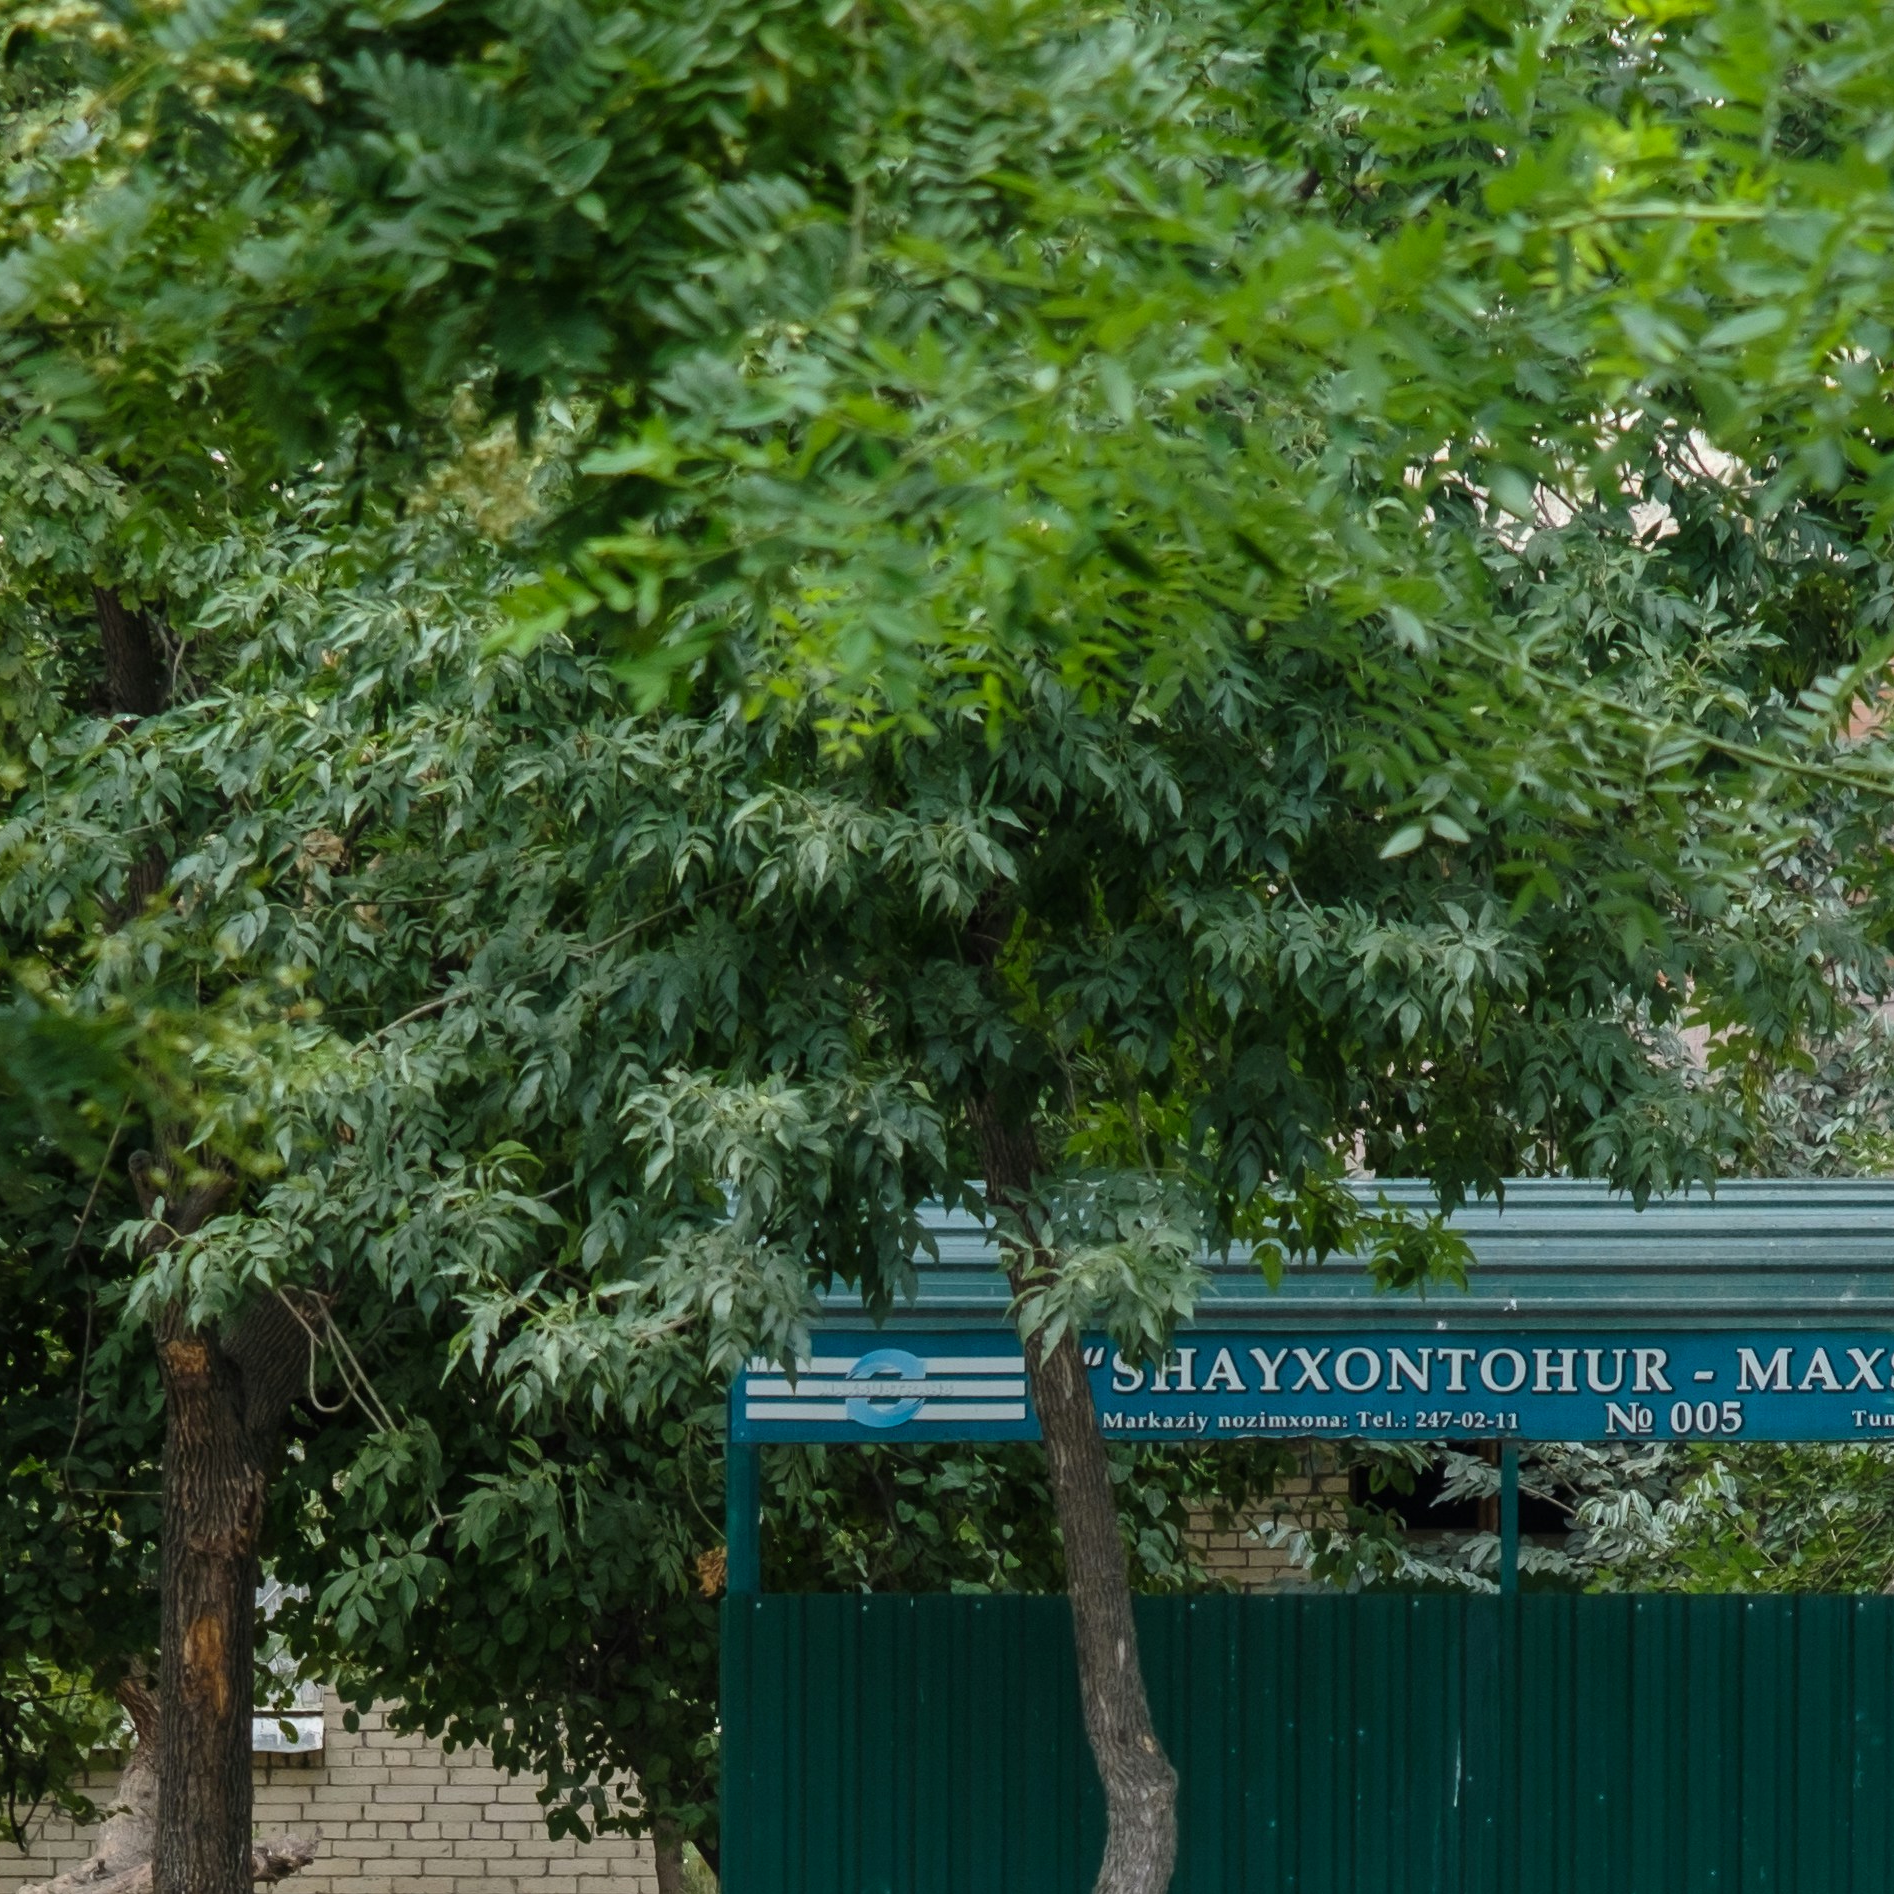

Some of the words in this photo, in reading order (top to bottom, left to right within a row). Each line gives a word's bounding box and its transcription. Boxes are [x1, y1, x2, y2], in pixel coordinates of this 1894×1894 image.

[1694, 1370, 1714, 1380] -
[1103, 1411, 1209, 1433] Markaziy
[1218, 1411, 1348, 1428] nozimxona:
[1357, 1410, 1407, 1428] Tel.:
[1415, 1411, 1519, 1429] 247-02-11
[1670, 1401, 1742, 1433] 005
